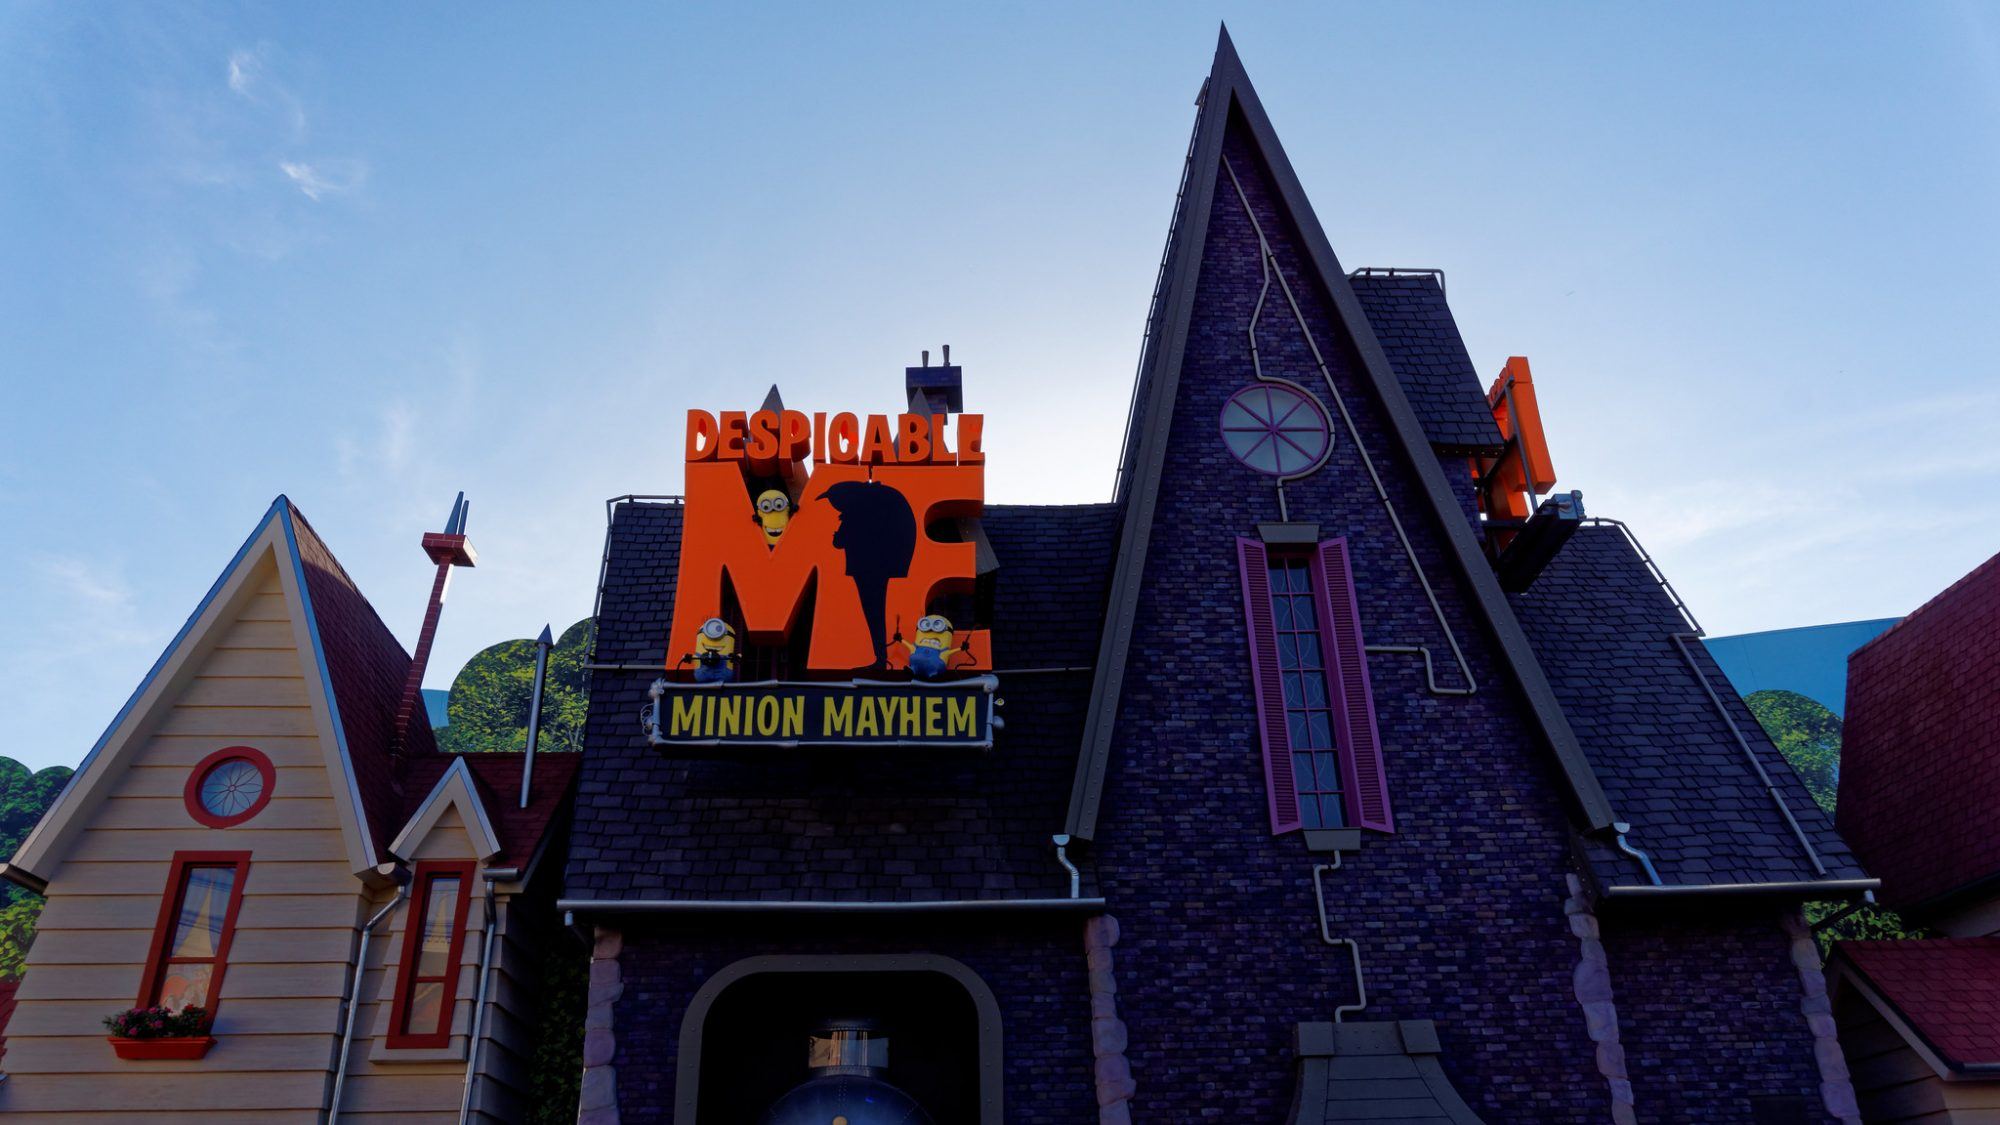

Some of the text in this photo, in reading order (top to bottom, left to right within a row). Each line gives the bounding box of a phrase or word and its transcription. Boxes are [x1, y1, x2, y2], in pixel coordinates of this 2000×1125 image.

[686, 409, 985, 464] DESPICABLE
[665, 462, 993, 672] ME
[671, 695, 977, 737] MINION MAYHEM
